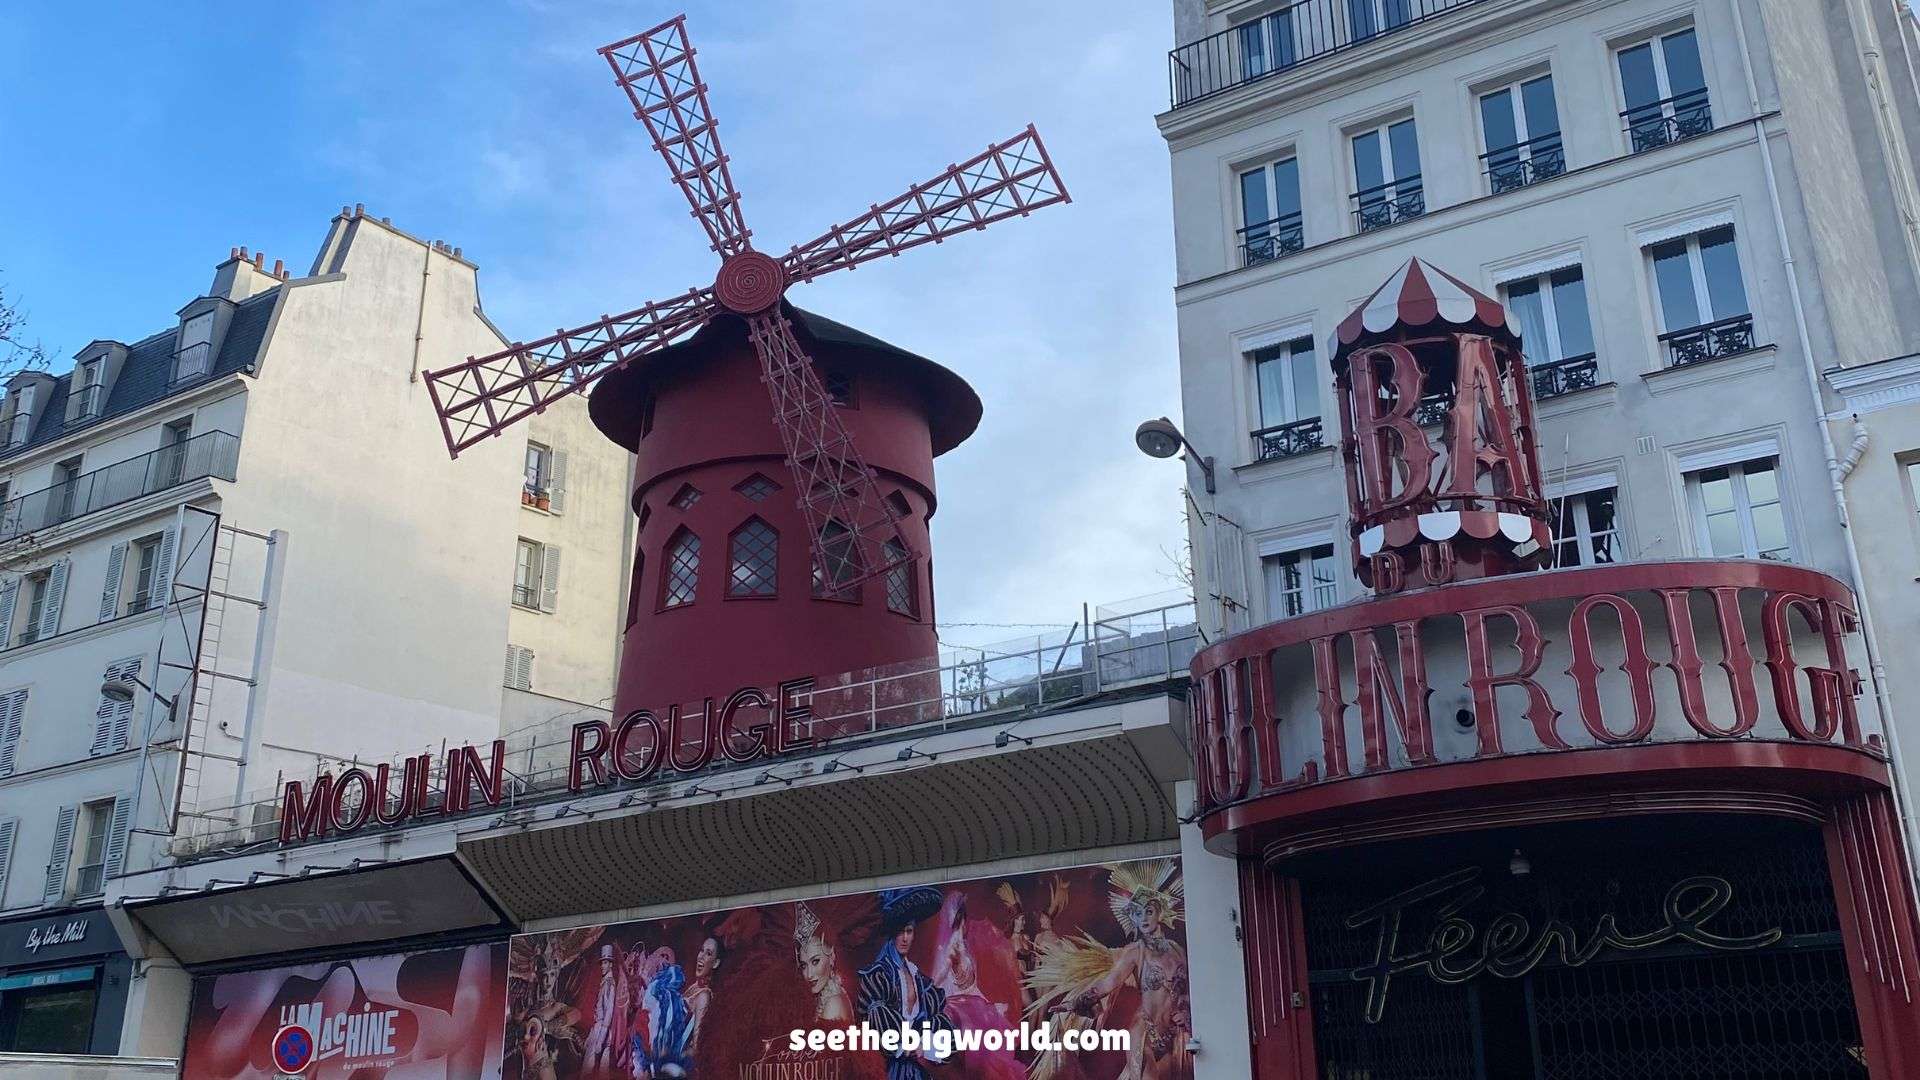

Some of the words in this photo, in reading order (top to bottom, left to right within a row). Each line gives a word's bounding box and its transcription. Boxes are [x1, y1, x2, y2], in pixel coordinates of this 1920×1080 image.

[1346, 333, 1544, 507] BA
[1371, 541, 1458, 596] DU
[279, 739, 506, 844] MOULIN
[567, 676, 818, 793] ROUGE
[1186, 620, 1435, 810] ULIN
[1456, 586, 1889, 759] ROUGE
[25, 927, 42, 954] By
[42, 924, 61, 946] the
[60, 919, 89, 943] Mill
